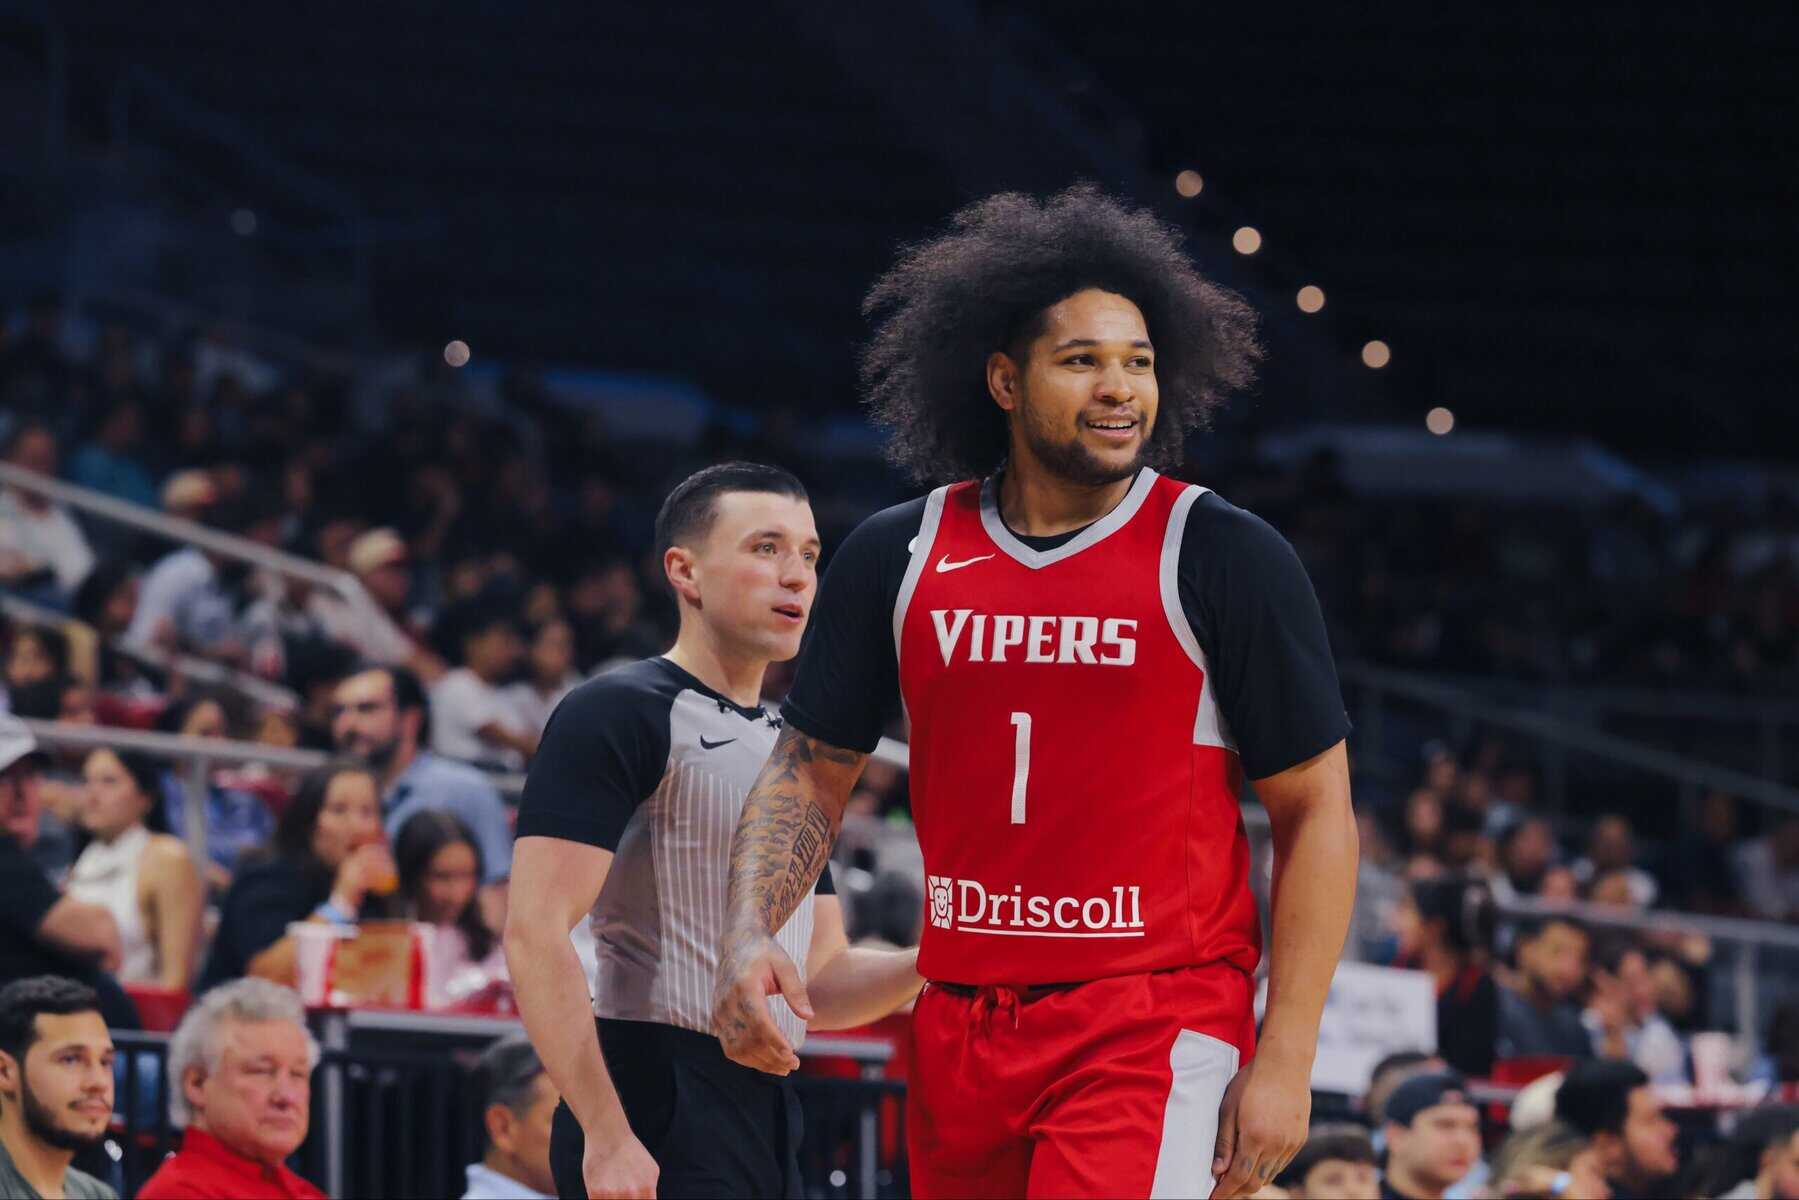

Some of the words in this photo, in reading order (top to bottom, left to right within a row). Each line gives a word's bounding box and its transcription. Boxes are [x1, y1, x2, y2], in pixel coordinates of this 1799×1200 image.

[930, 609, 1138, 668] VIPERS
[1010, 711, 1033, 825] 1
[957, 879, 1145, 929] Driscoll
